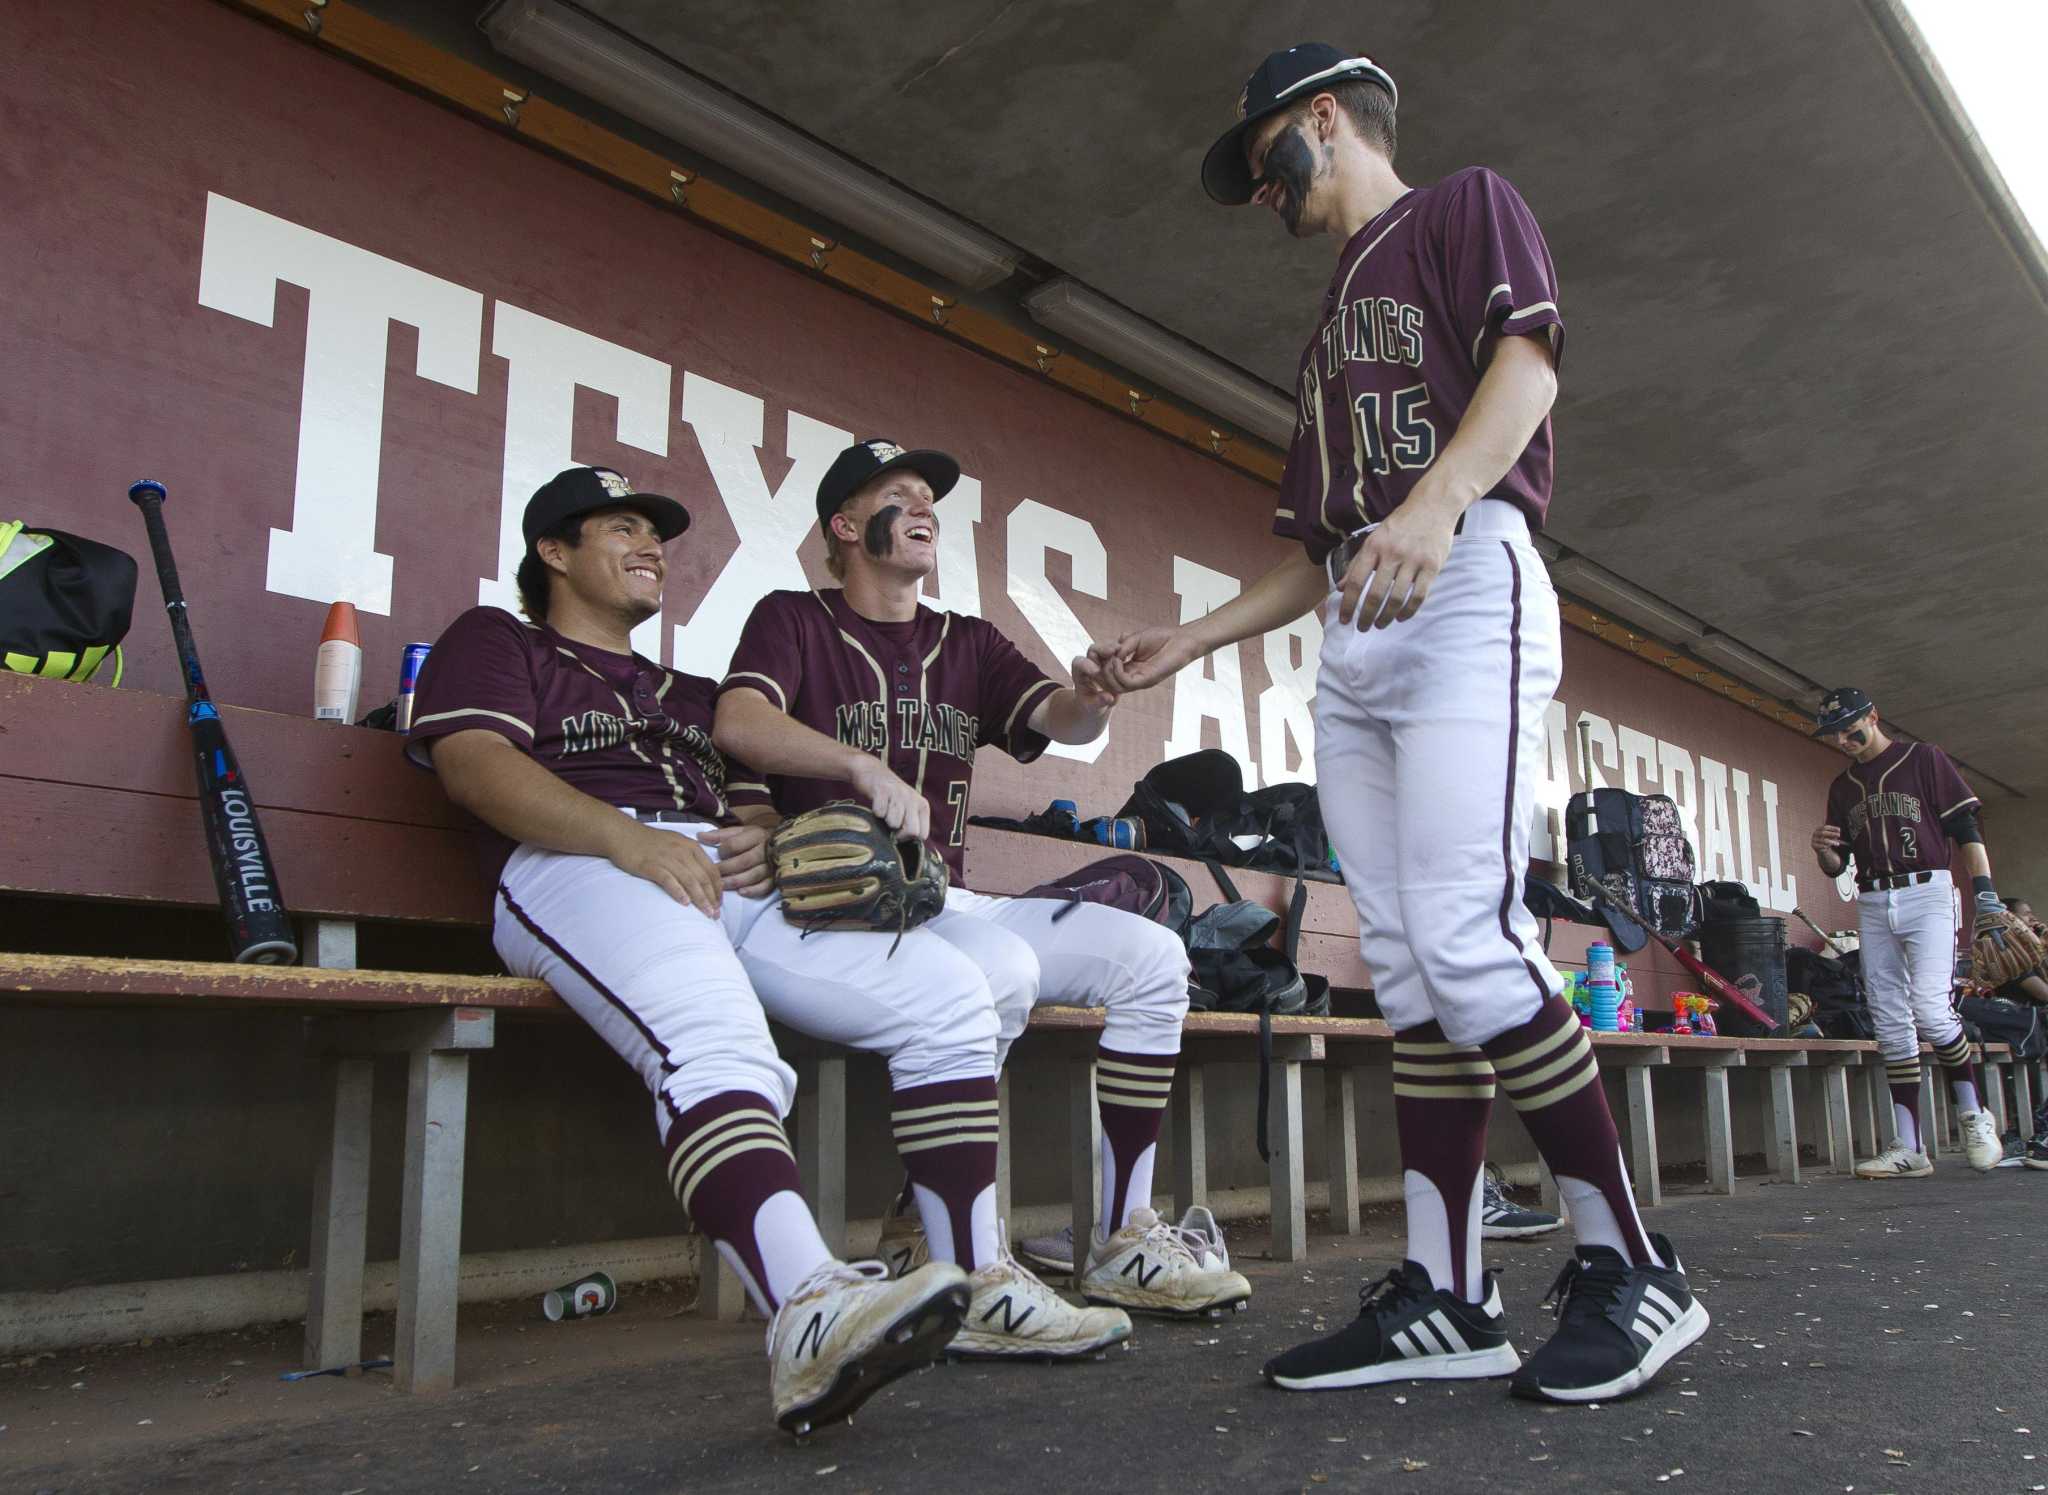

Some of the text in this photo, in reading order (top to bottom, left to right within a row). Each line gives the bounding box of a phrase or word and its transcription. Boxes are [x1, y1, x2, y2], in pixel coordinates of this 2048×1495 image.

[1355, 382, 1436, 475] 15
[1163, 554, 1325, 793] A&
[1529, 699, 1798, 914] ABALL
[948, 781, 969, 846] 7
[220, 789, 274, 913] LOUISVILLE
[1899, 826, 1918, 859] 2
[1120, 1252, 1162, 1288] N
[795, 1311, 840, 1359] N
[981, 1294, 1035, 1333] N
